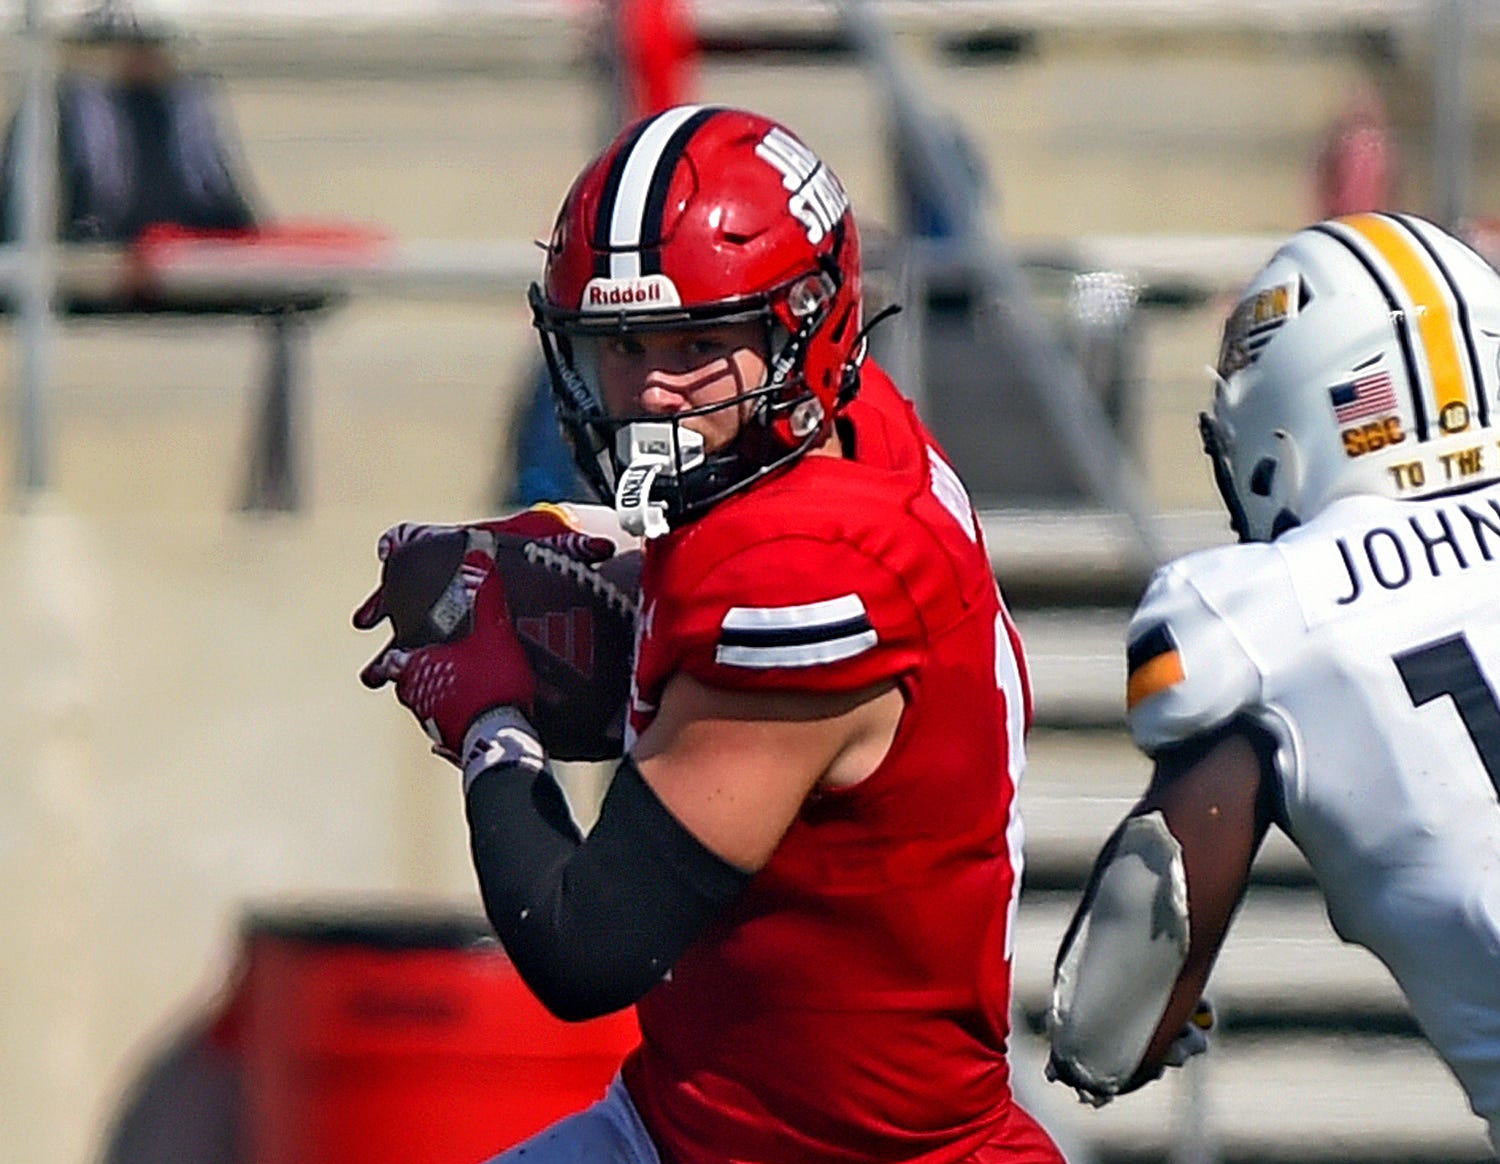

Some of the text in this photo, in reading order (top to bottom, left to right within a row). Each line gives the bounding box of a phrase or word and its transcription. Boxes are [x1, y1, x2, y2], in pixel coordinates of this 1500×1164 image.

[590, 282, 660, 305] Riddell
[1341, 416, 1406, 458] SBC
[1389, 460, 1425, 490] TO
[1439, 446, 1484, 480] THE
